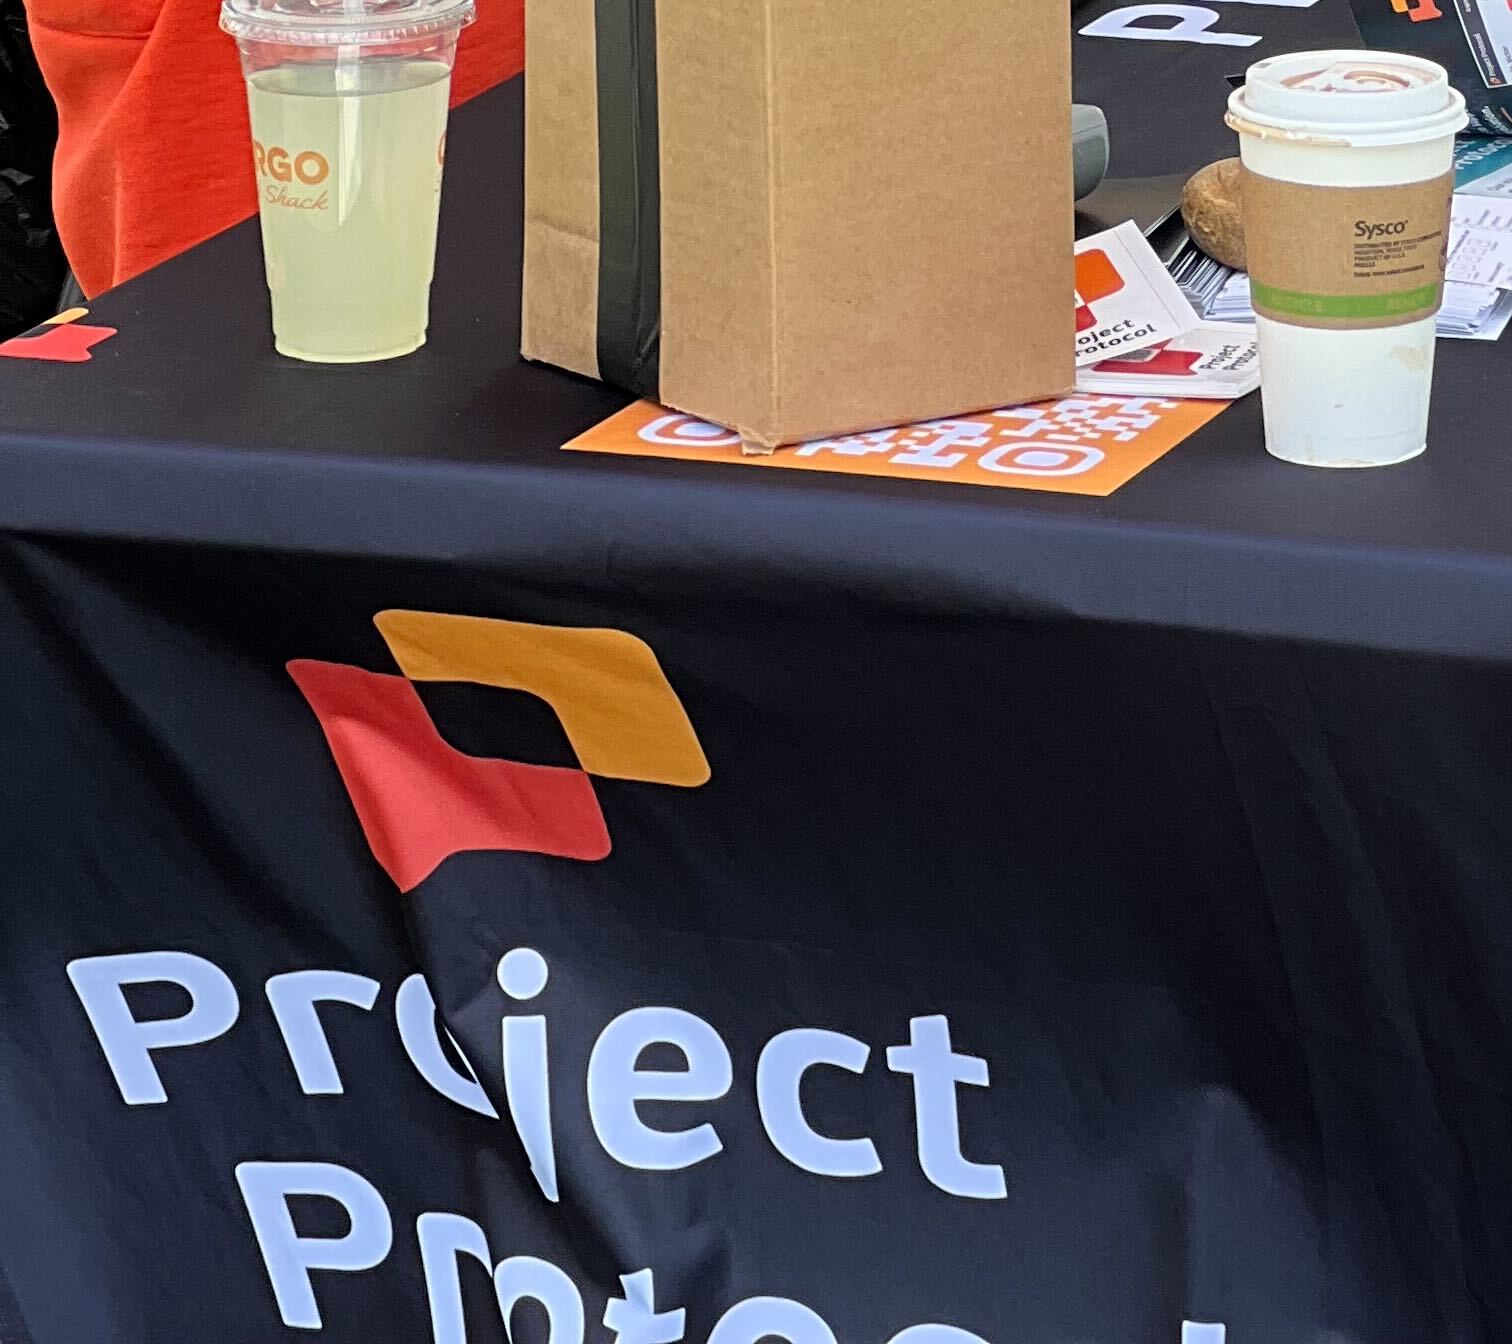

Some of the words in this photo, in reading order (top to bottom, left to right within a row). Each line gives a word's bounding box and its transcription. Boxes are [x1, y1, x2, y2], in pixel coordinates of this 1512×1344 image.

[265, 185, 328, 210] Shack
[1354, 220, 1405, 241] Sysco
[1075, 324, 1156, 357] rotocol
[1077, 319, 1135, 345] oject
